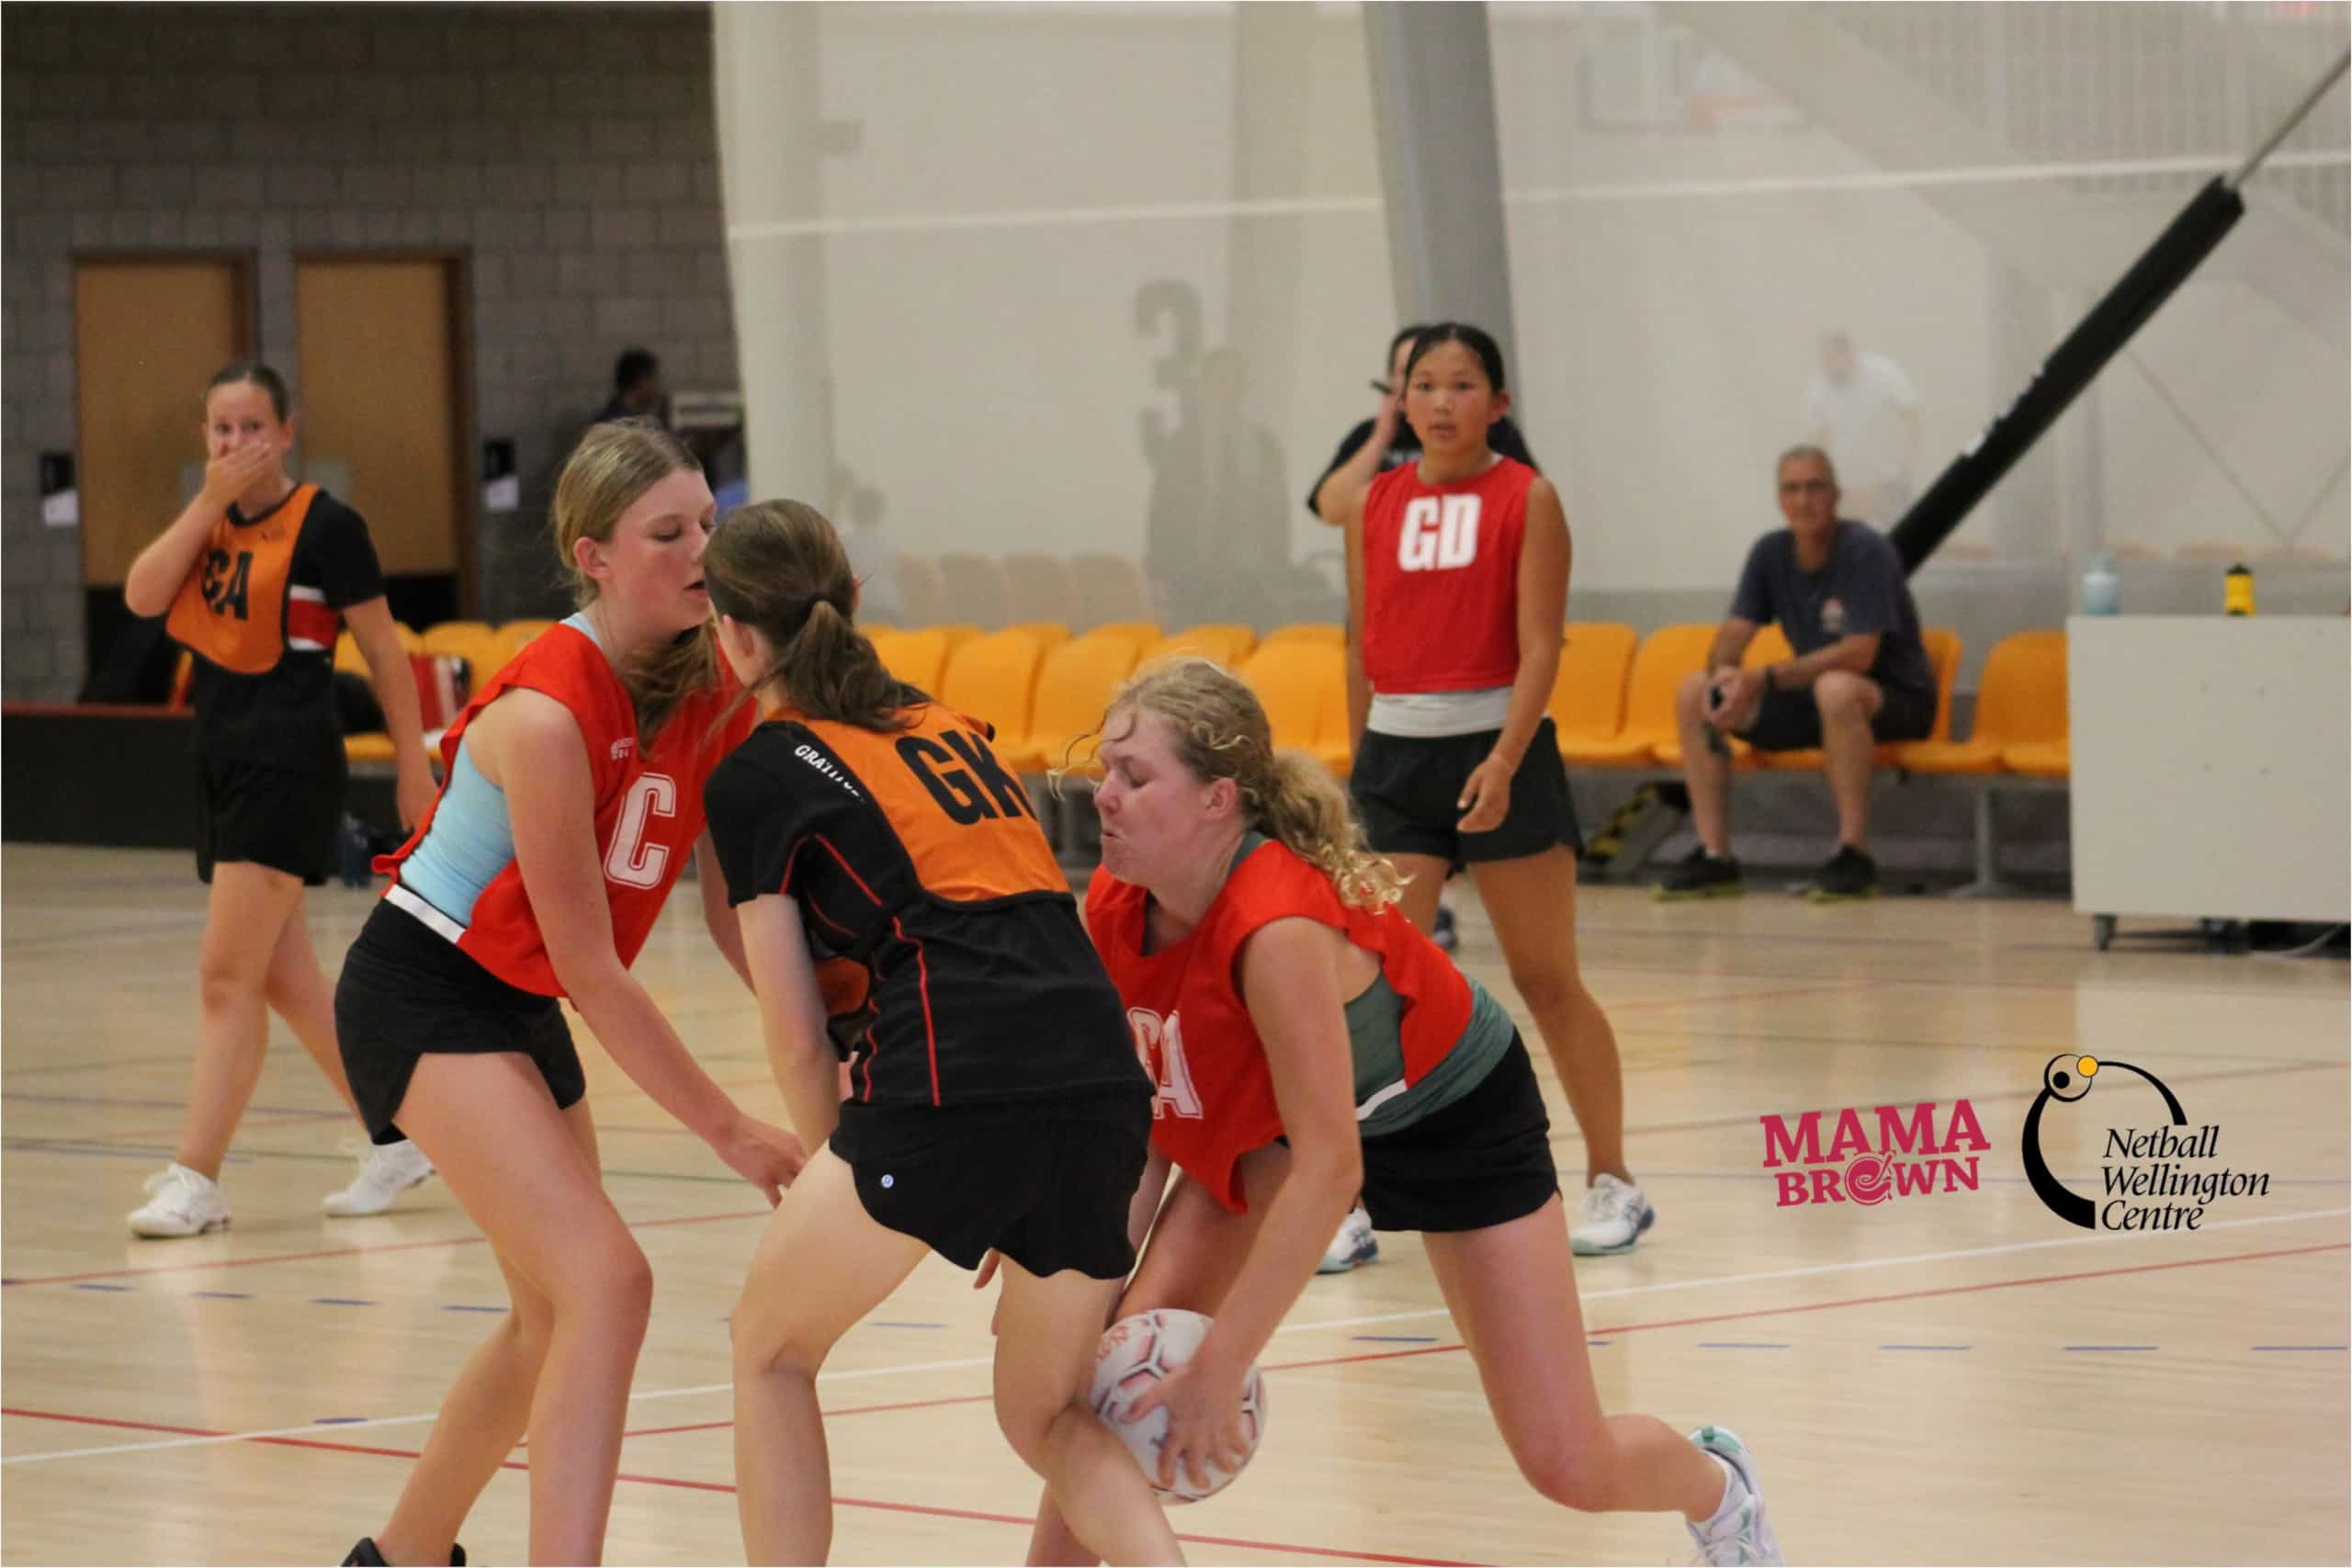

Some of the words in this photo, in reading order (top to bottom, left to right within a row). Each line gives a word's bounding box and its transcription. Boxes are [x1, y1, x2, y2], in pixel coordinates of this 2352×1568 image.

[1134, 278, 1203, 465] 3
[1397, 493, 1483, 572] GD
[603, 771, 677, 890] C
[895, 729, 1038, 826] GK
